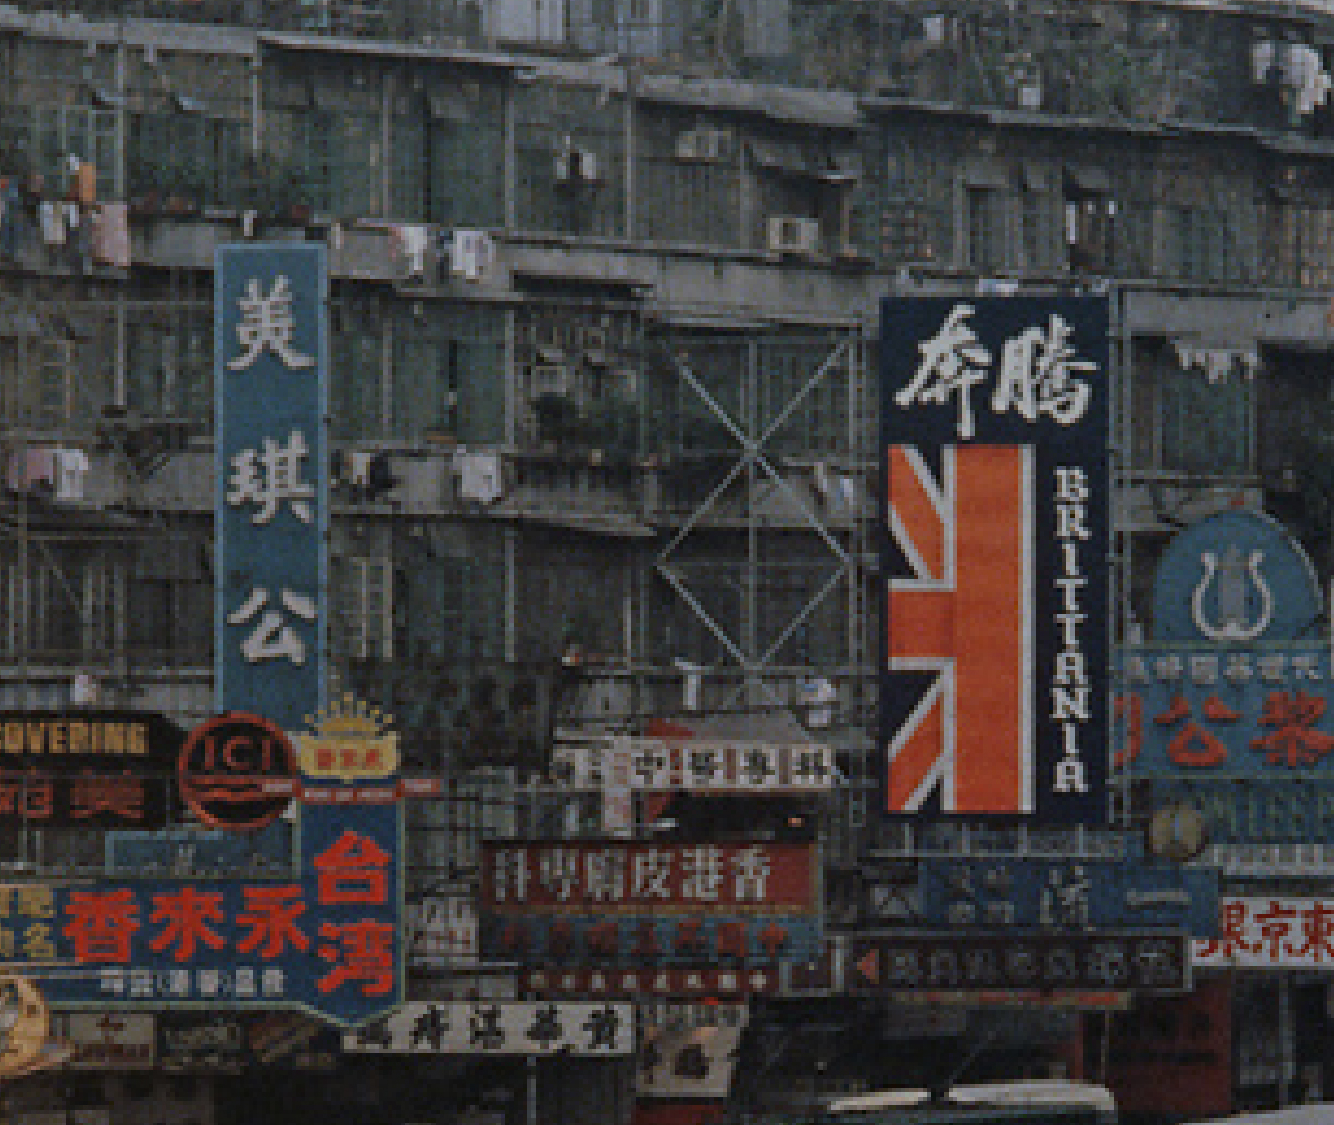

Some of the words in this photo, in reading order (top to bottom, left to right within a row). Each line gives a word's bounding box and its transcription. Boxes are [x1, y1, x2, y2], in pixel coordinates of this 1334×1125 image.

[227, 275, 315, 663] 美琪公
[894, 304, 1097, 441] 奔騰
[1054, 466, 1091, 792] BRITTANIA
[204, 733, 274, 772] ICI
